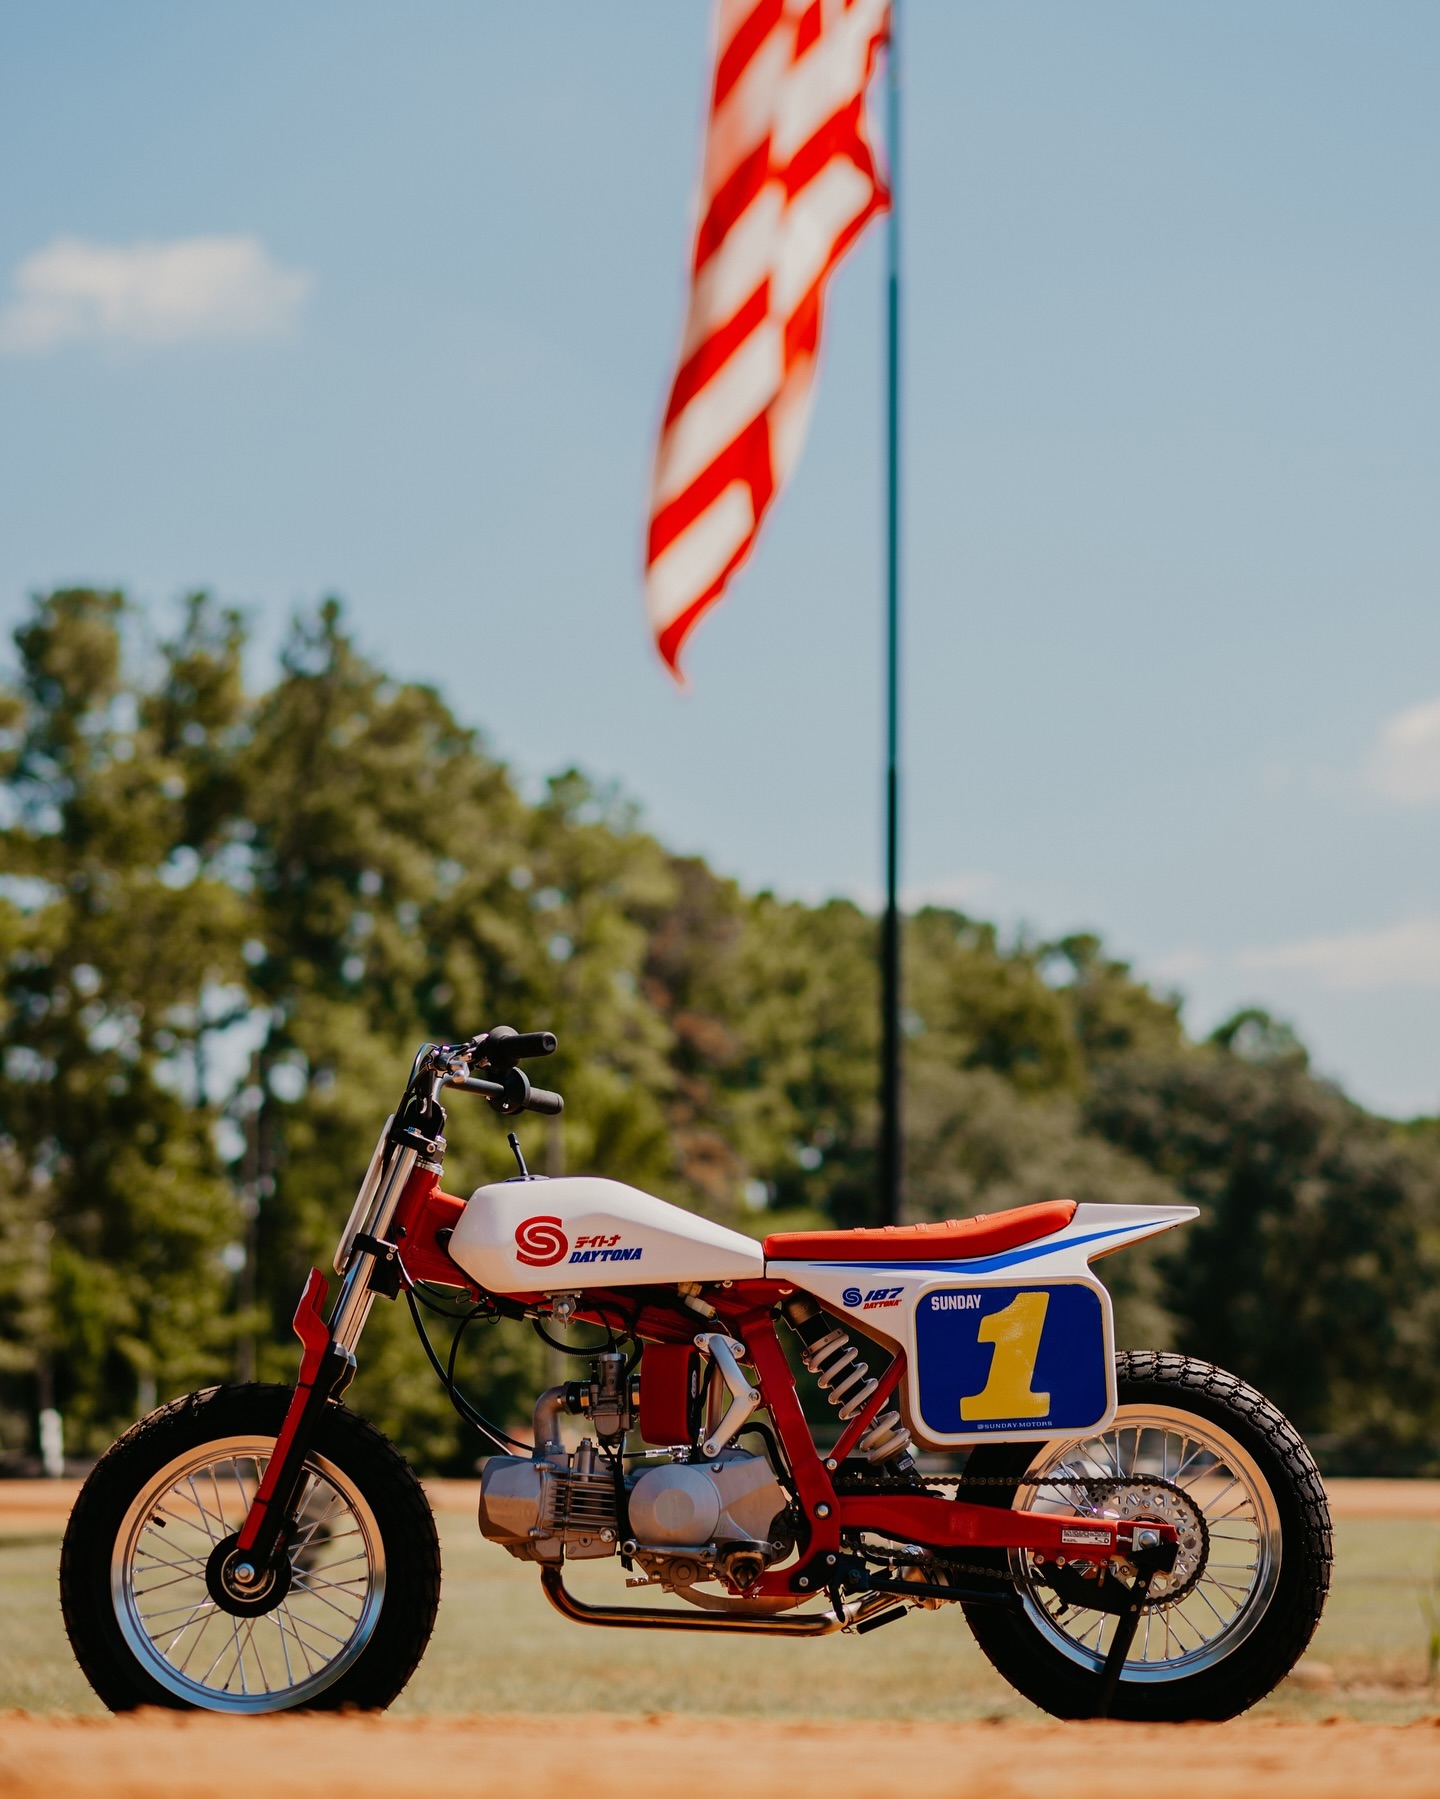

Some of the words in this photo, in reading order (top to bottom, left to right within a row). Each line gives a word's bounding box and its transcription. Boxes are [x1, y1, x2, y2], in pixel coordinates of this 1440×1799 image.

[575, 1234, 621, 1248] デイトナ
[568, 1248, 643, 1263] DAYTONA
[864, 1287, 905, 1302] 187
[863, 1299, 901, 1310] DAYTONA
[931, 1294, 982, 1311] SUNDAY
[960, 1291, 1051, 1421] 1
